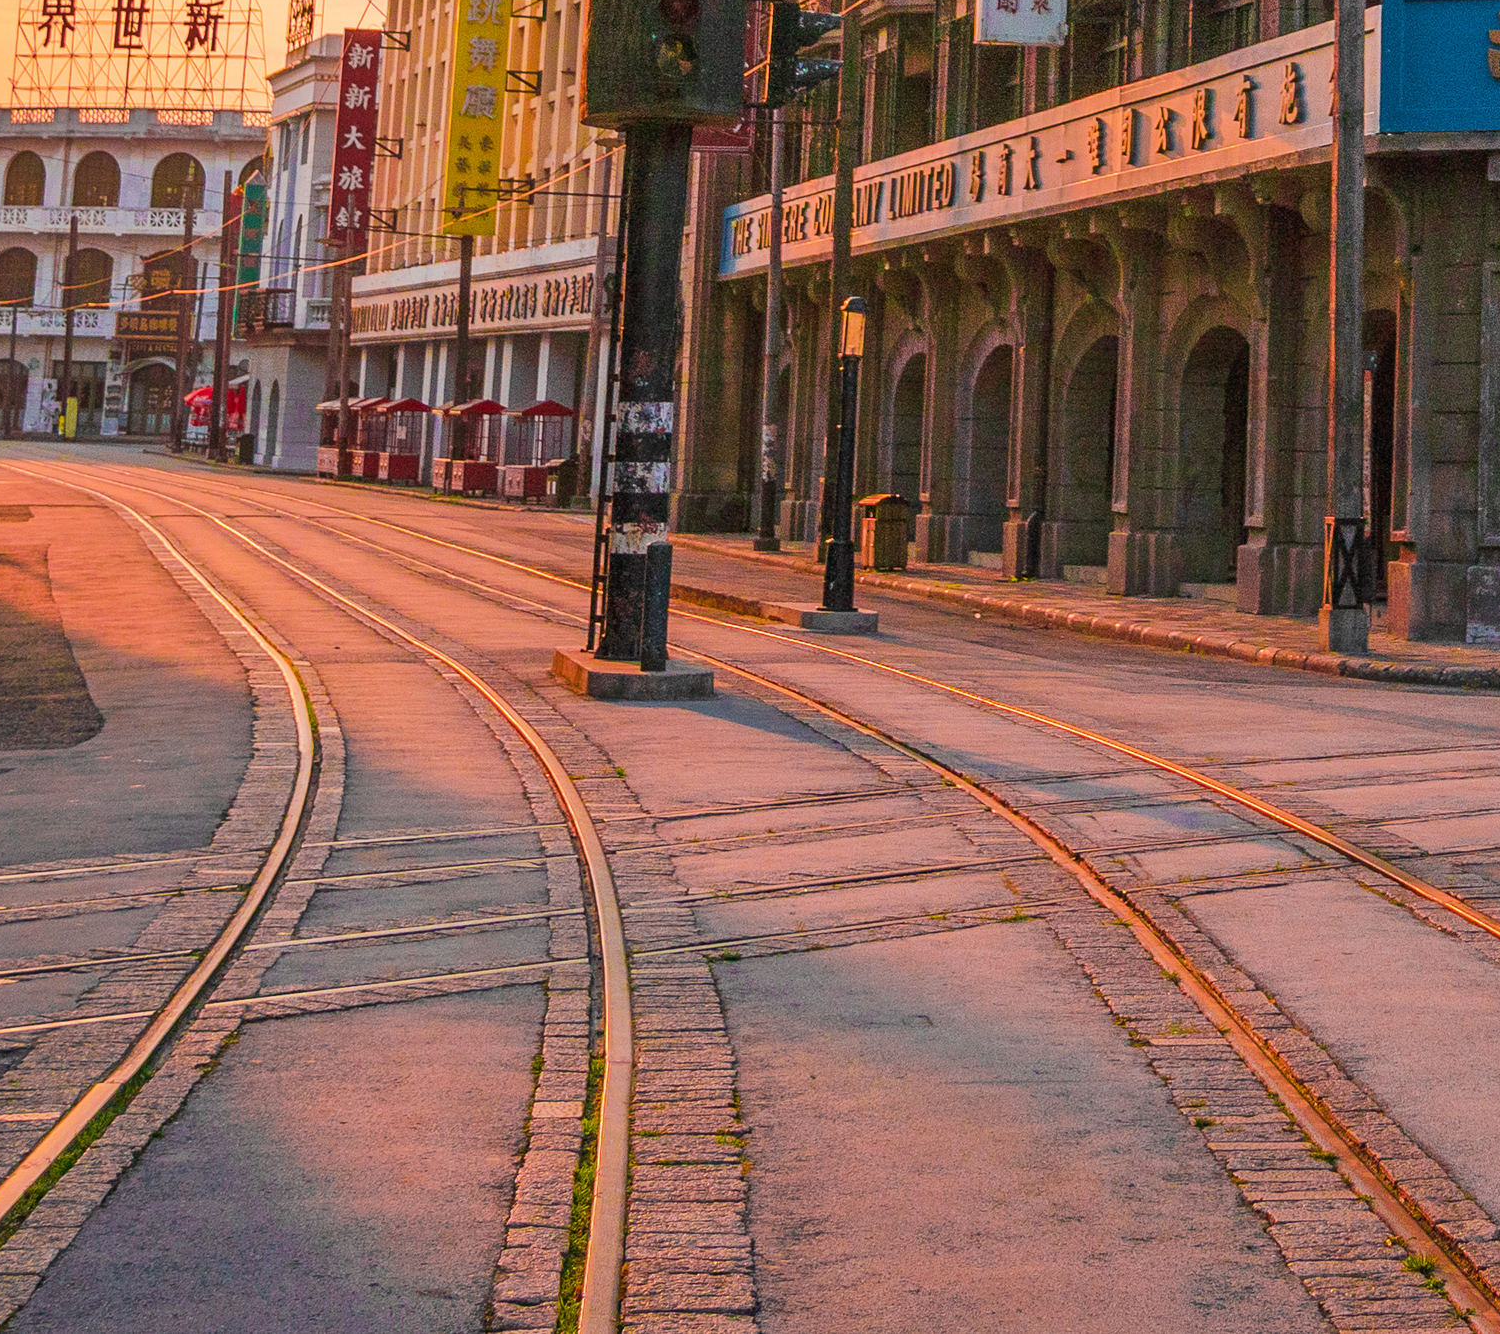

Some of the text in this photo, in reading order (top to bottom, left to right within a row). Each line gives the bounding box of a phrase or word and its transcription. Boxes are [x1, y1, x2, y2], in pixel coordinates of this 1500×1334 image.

[732, 216, 753, 256] THE
[757, 200, 808, 250] SINERE
[888, 160, 955, 221] LIMITED
